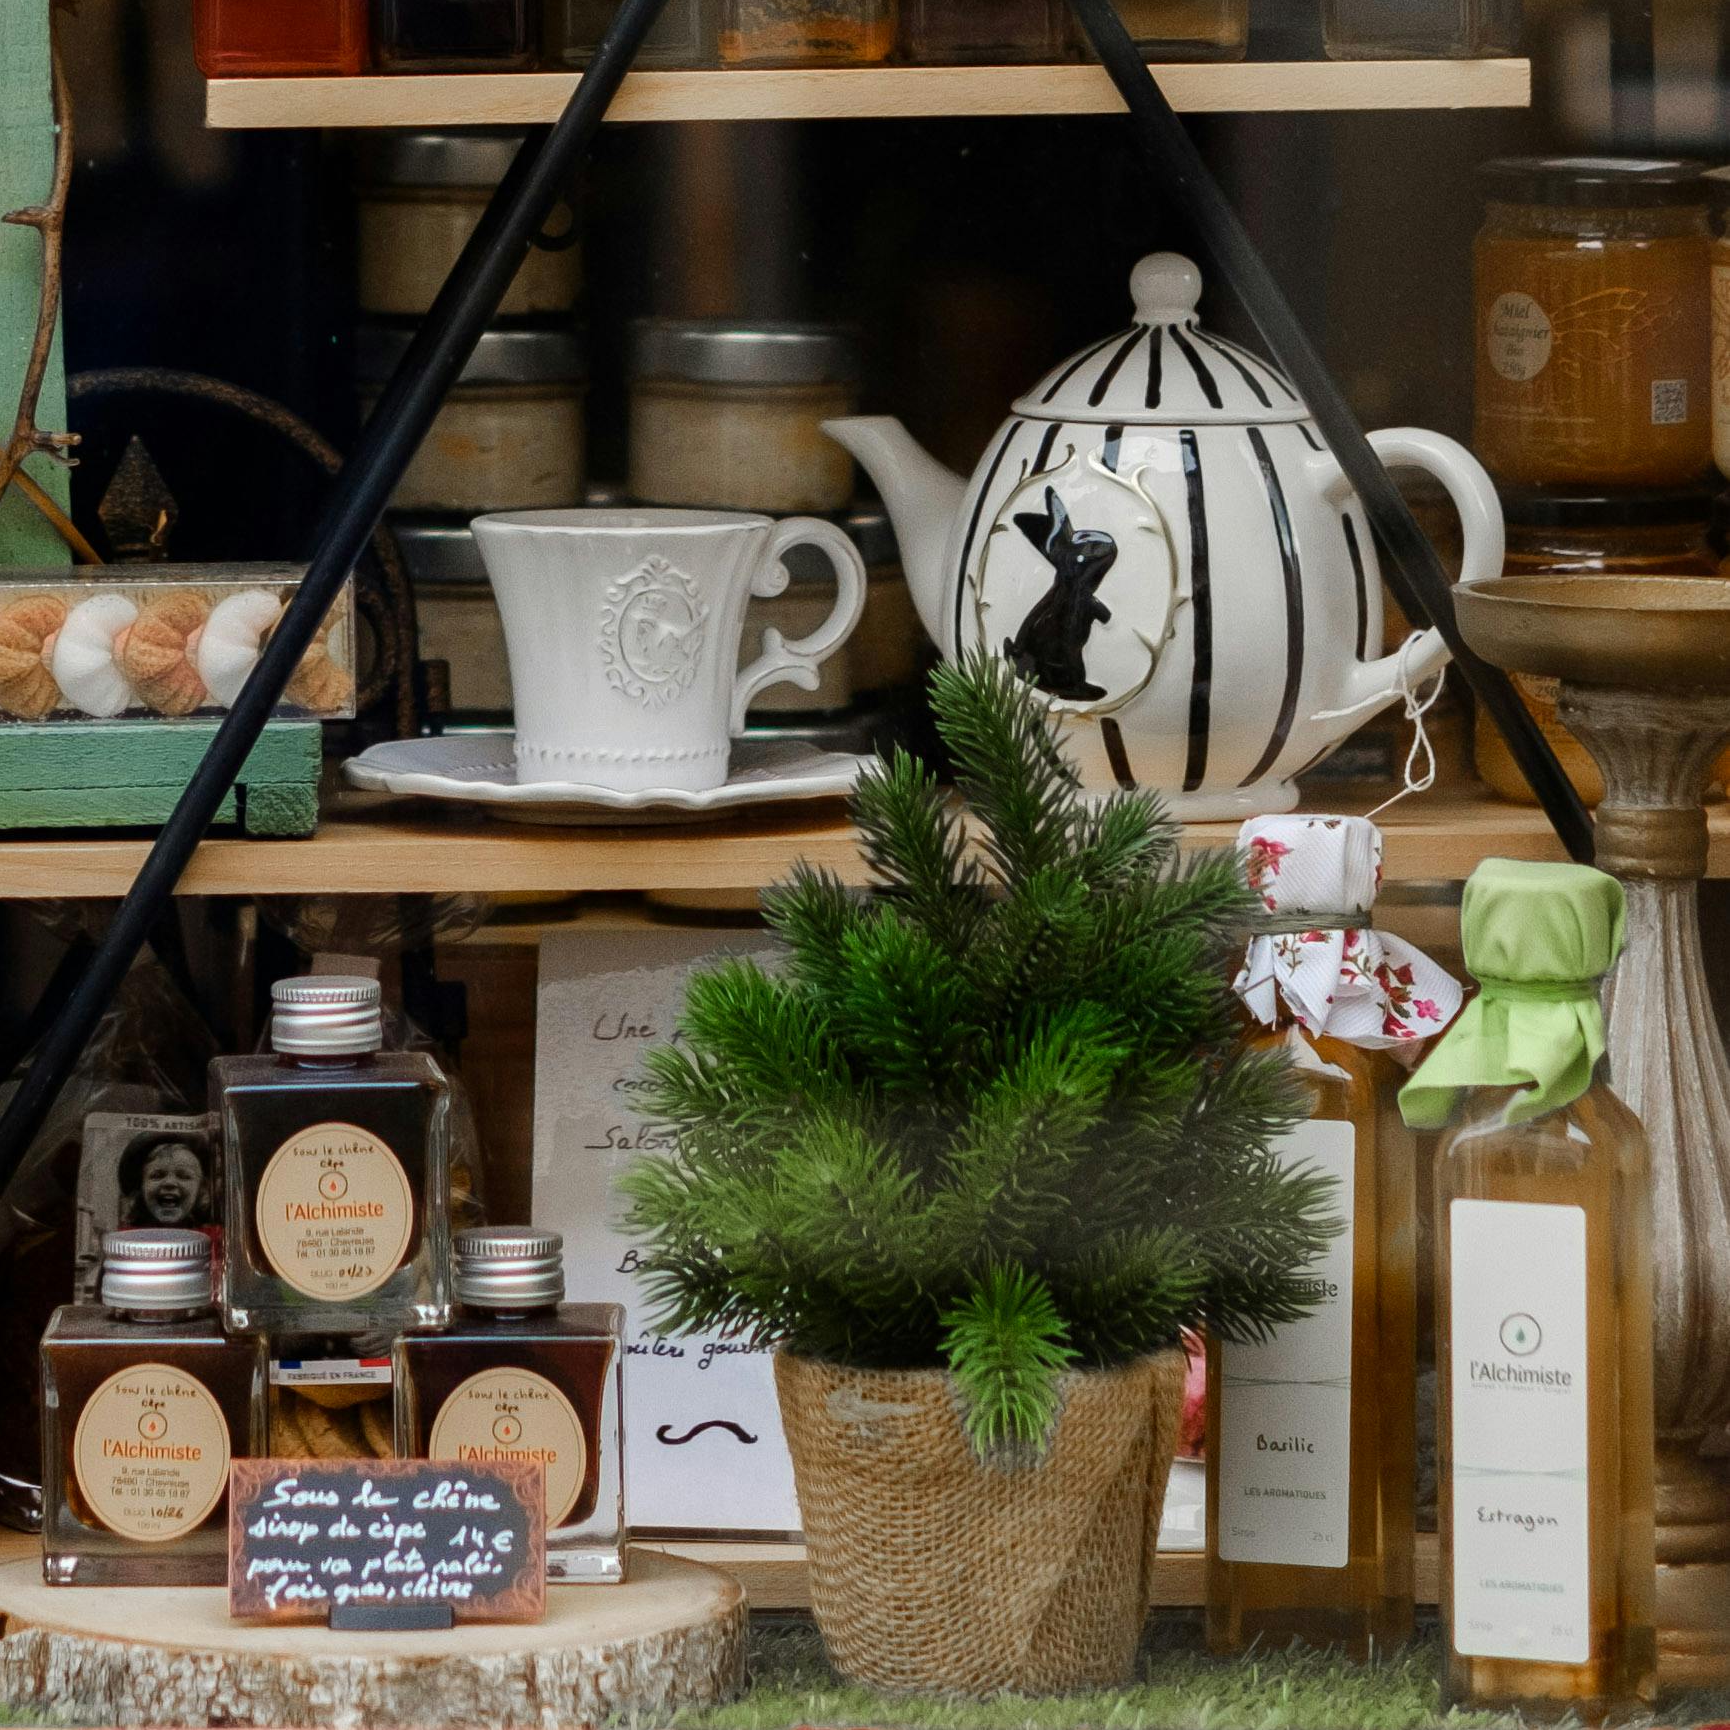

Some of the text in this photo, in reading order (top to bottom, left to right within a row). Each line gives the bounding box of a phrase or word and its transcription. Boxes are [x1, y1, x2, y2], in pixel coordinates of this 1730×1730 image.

[592, 1012, 657, 1041] Une
[285, 1200, 384, 1223] l'Alchimiste
[622, 1330, 686, 1358] oûters
[1469, 1360, 1572, 1387] l'Alchimiste
[102, 1437, 202, 1462] l'Alchimiste
[458, 1444, 557, 1464] l'Alchimiste
[1256, 1433, 1315, 1455] Basilic
[263, 1478, 501, 1511] Sous le chêne
[1243, 1486, 1327, 1501] LES AROMATIQUES
[248, 1511, 320, 1546] sirop
[327, 1513, 362, 1539] de
[368, 1512, 427, 1549] cèpe
[491, 1529, 515, 1553] €
[1476, 1505, 1559, 1532] Estragon
